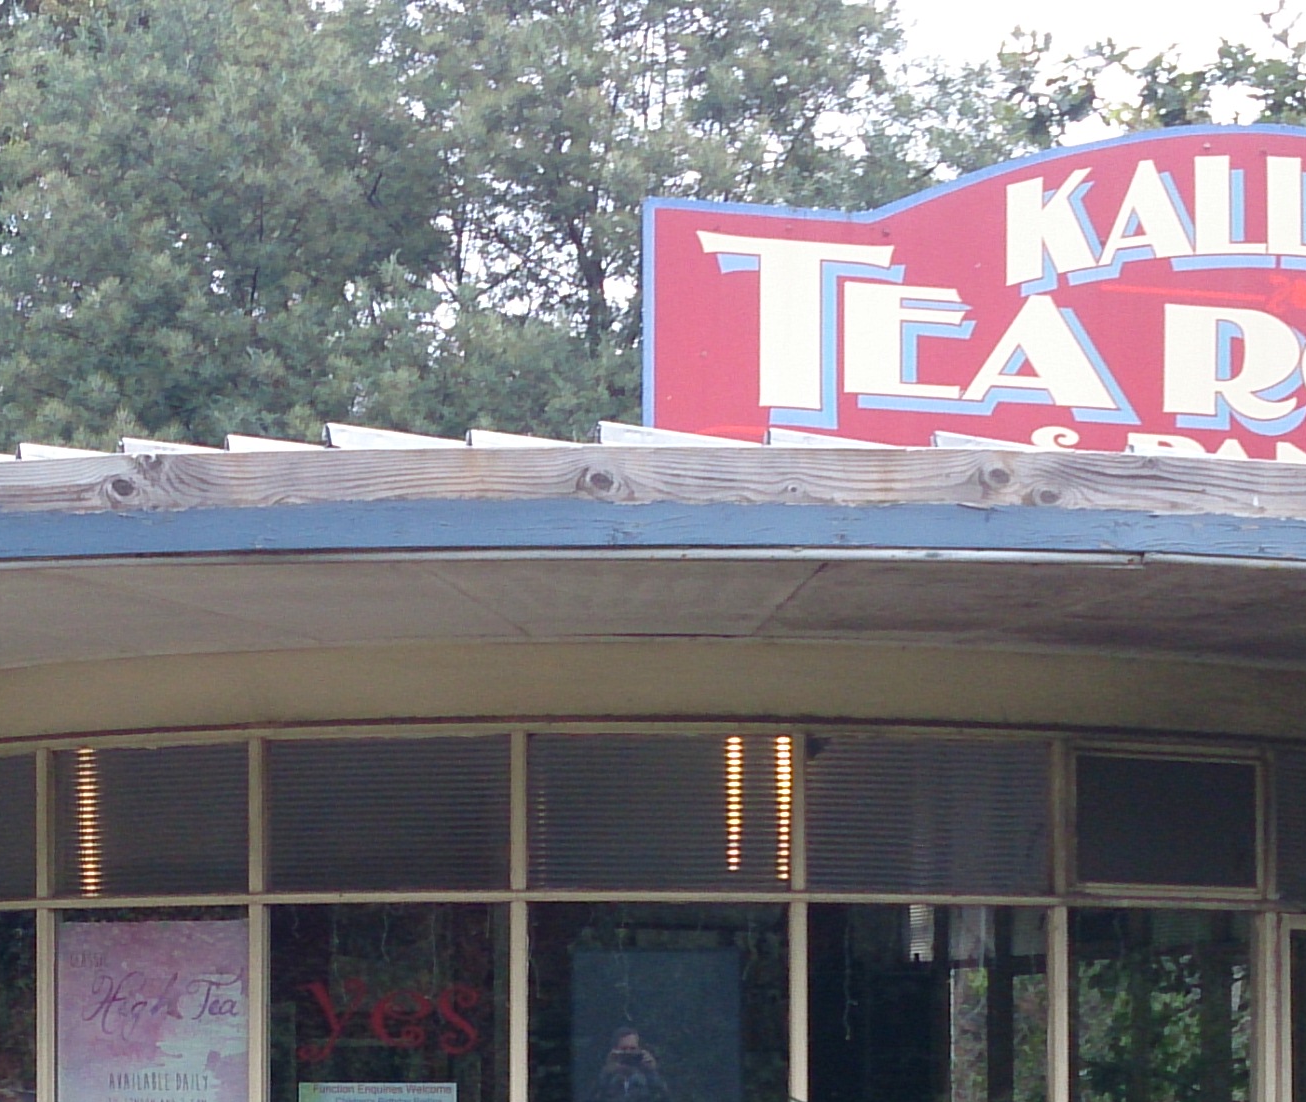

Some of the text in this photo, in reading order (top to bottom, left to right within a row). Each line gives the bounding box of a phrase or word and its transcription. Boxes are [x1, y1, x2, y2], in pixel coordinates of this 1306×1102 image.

[696, 230, 1121, 411] TEA
[186, 967, 244, 1020] Tea
[109, 1071, 209, 1092] AVAILABLE DAILY
